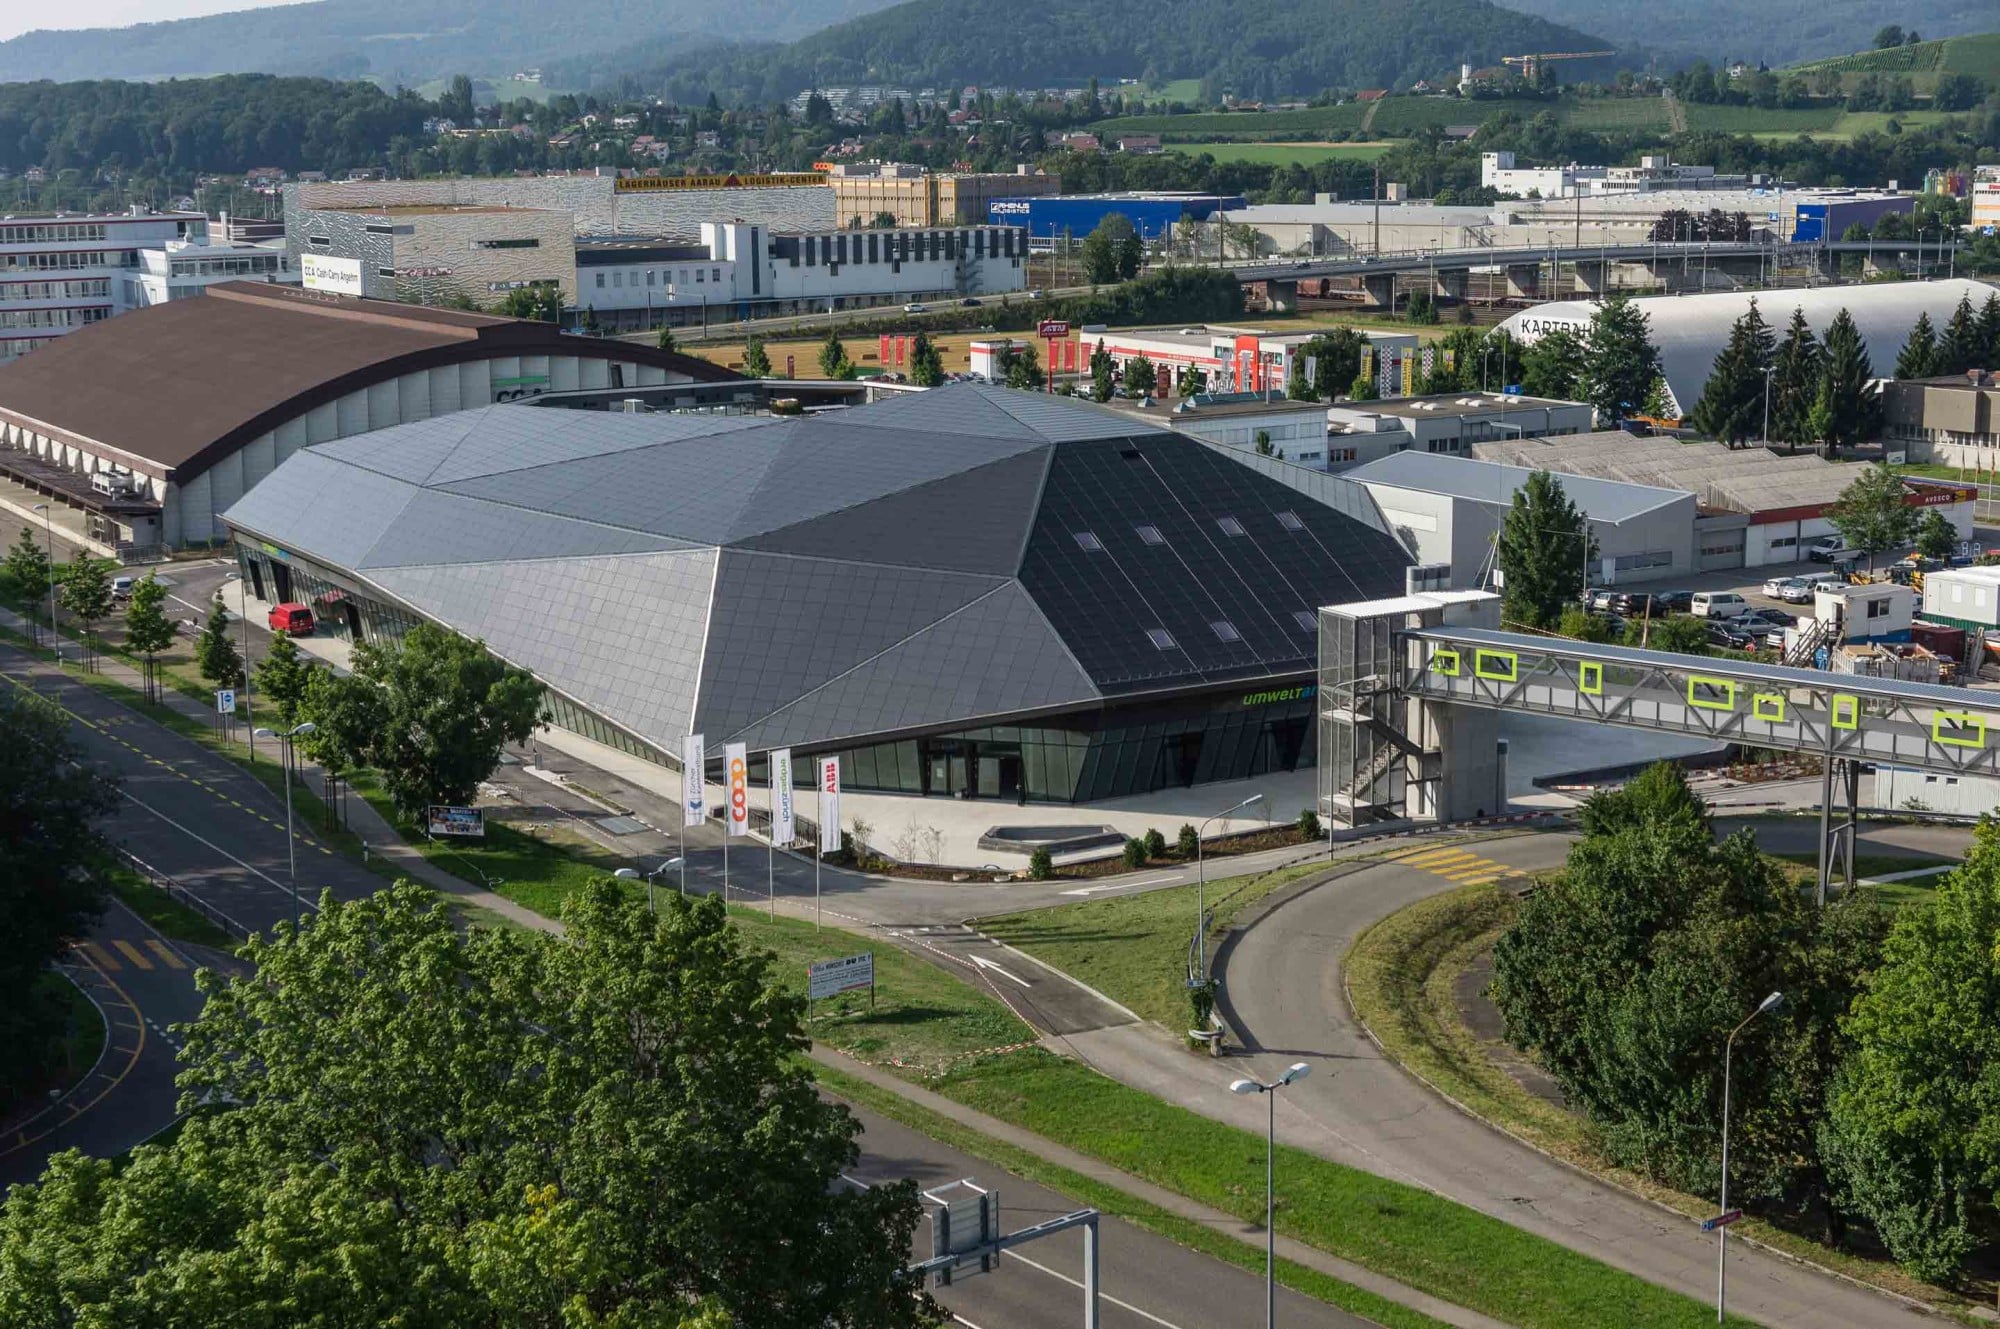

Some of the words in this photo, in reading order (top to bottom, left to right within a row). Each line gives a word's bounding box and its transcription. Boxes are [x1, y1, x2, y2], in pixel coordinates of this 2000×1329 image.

[690, 177, 721, 187] AARAU
[744, 174, 825, 186] LOGISTIK-CENTER
[1521, 319, 1593, 338] KARTBAH
[1925, 494, 1951, 504] AVESCO
[825, 762, 836, 794] ABB
[730, 757, 747, 823] coop
